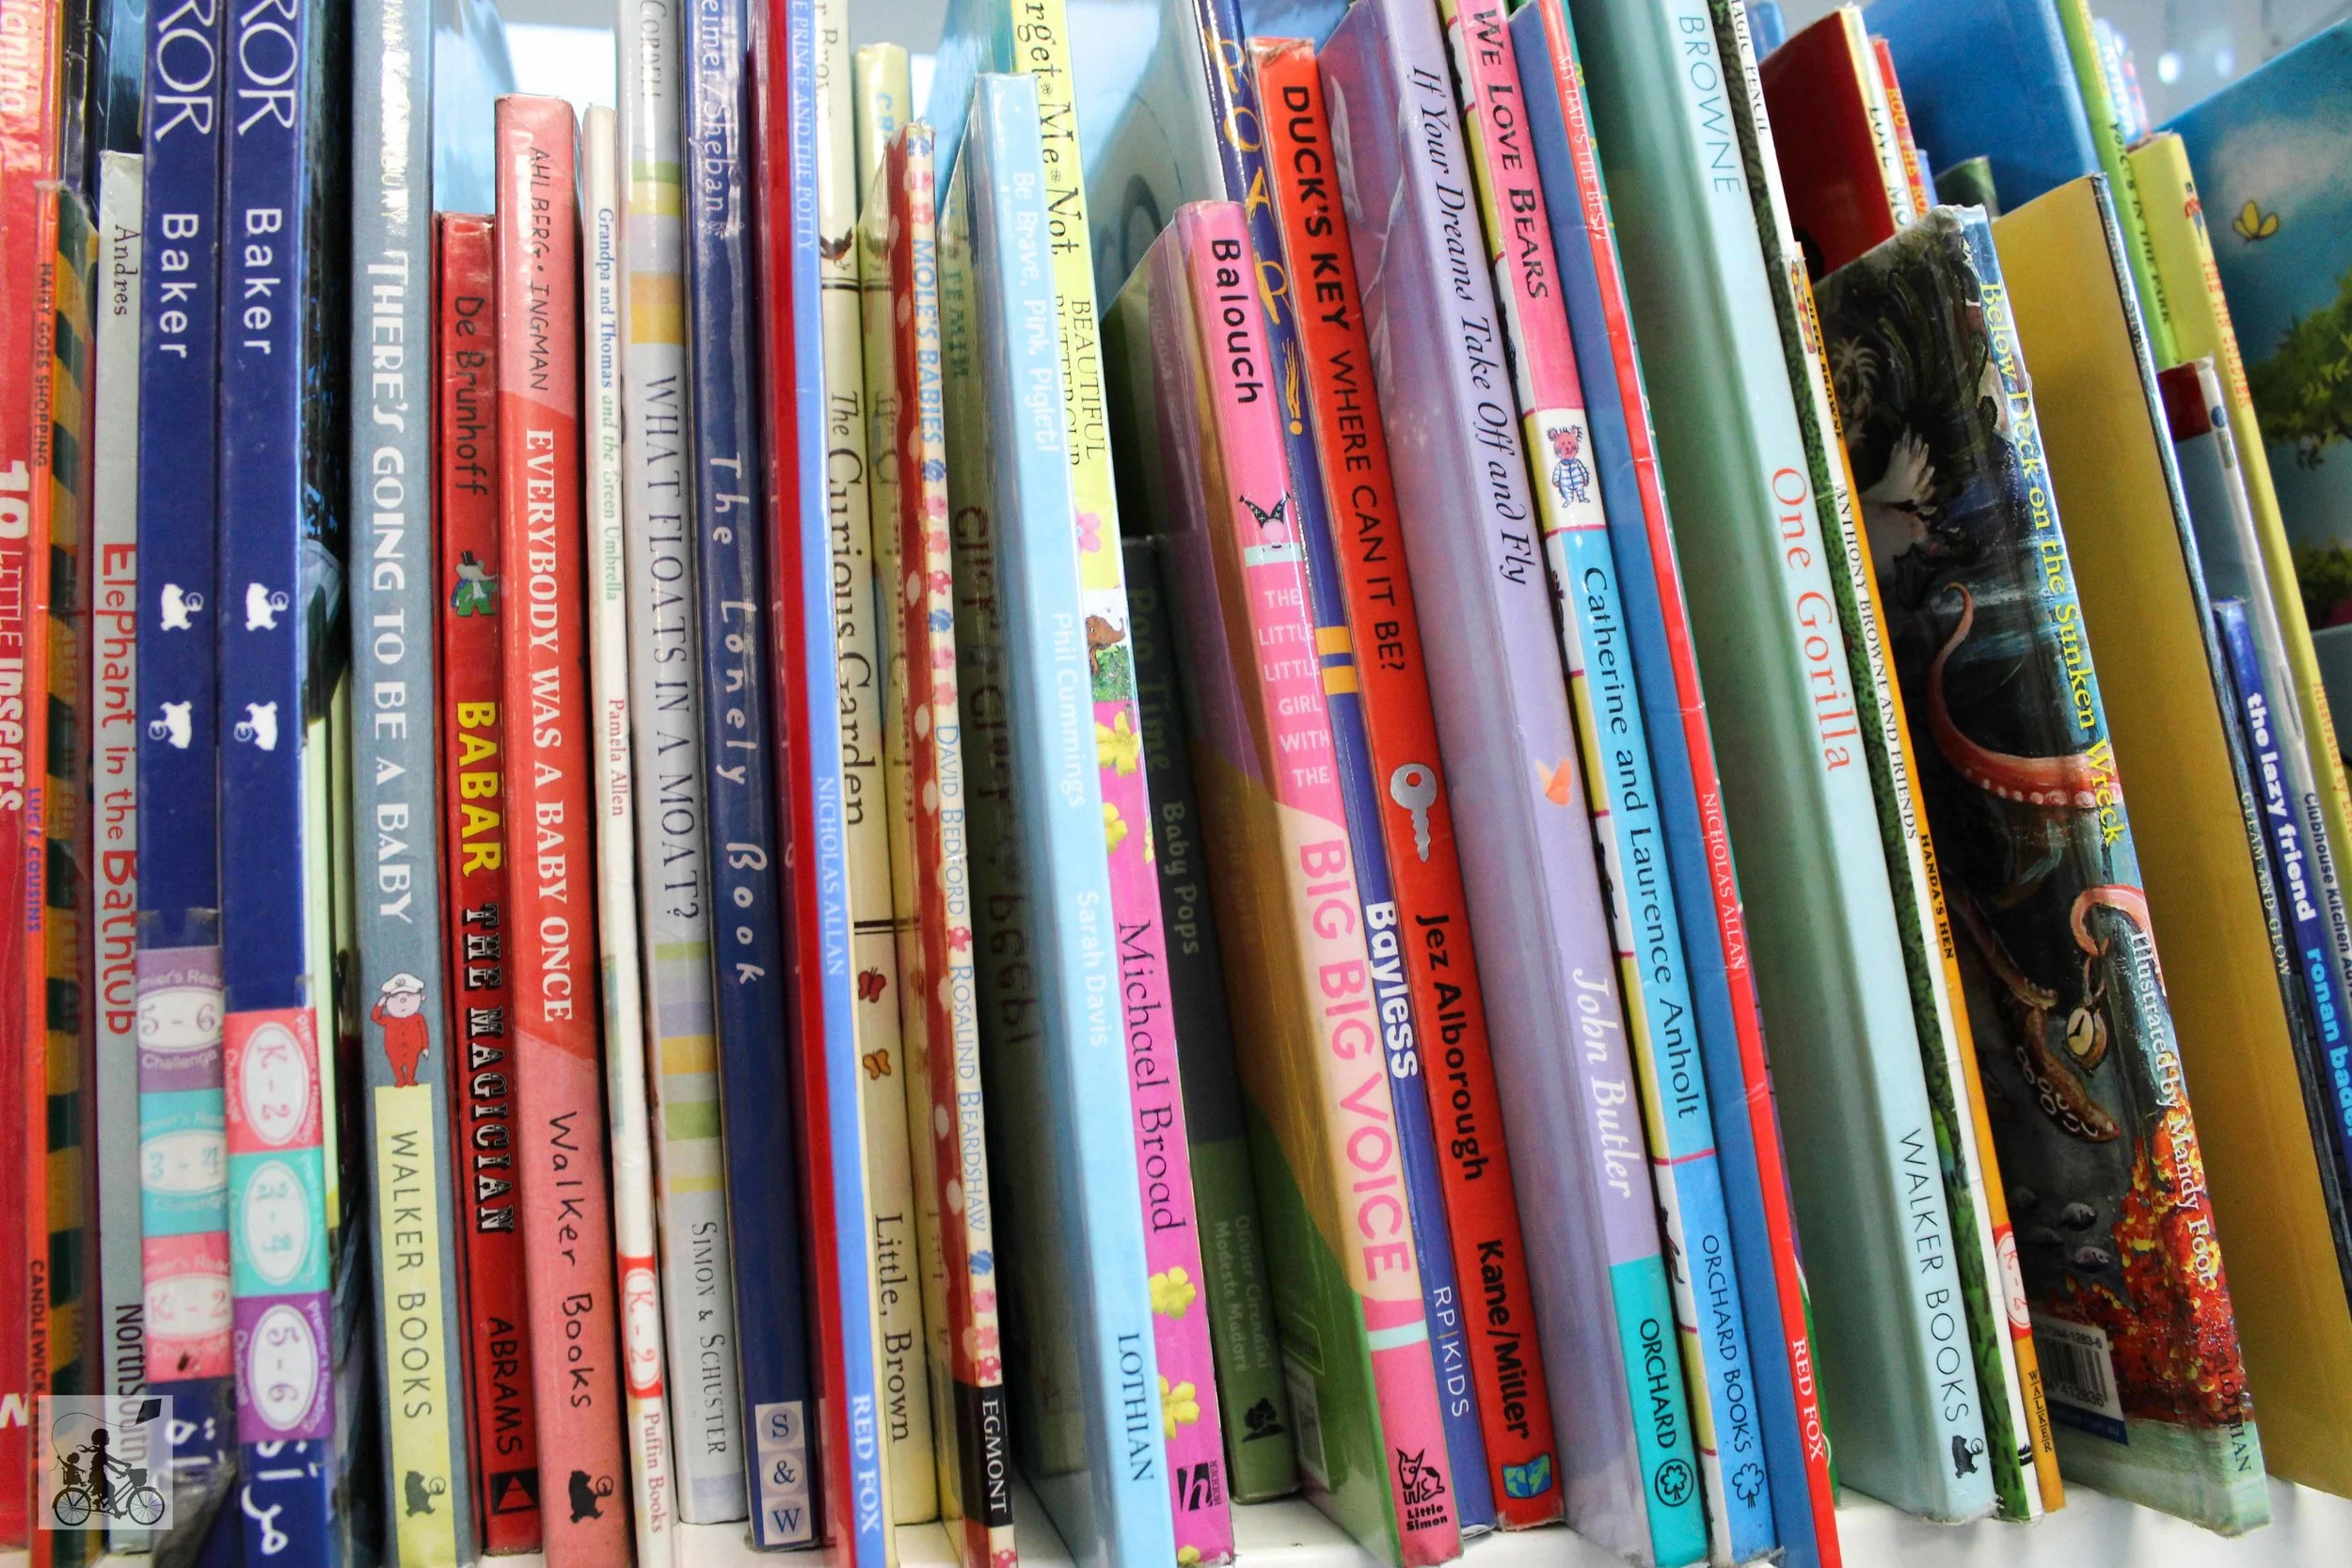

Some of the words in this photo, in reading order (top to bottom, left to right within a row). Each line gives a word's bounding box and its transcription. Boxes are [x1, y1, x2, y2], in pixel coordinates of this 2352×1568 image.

[792, 17, 810, 87] PRINCE
[1474, 8, 1502, 67] WE
[794, 93, 811, 137] AND
[1420, 103, 1452, 175] Your
[1486, 85, 1522, 171] LOVE
[1678, 16, 1741, 194] BROWNE
[795, 142, 812, 181] THE
[1015, 172, 1036, 200] Be
[1281, 85, 1332, 237] DUCK'S
[530, 148, 551, 270] AHLBERG
[596, 208, 616, 281] Grandpa
[797, 186, 814, 252] POTTY
[1014, 211, 1039, 285] Brave,
[1435, 181, 1474, 303] Dreams
[1508, 187, 1549, 300] BEARS
[40, 263, 52, 315] MAISY
[113, 224, 141, 317] Andres
[160, 214, 199, 358] Baker
[455, 295, 485, 338] De
[599, 284, 615, 315] and
[912, 240, 936, 341] MOLE'S
[1311, 251, 1351, 331] KEY
[38, 321, 50, 369] GOES
[366, 249, 409, 435] THERE'S
[530, 279, 549, 391] INGMAN
[600, 320, 617, 388] Thomas
[1024, 299, 1047, 357] Pink
[1212, 239, 1264, 404] Balouch
[1460, 315, 1500, 391] Take
[1980, 281, 2017, 381] Below
[36, 374, 50, 467] SHOPPING
[455, 351, 487, 496] Brunhoff
[601, 395, 616, 424] and
[831, 391, 858, 436] The
[916, 349, 944, 444] BABIES
[1029, 368, 1060, 451] Piglet!
[1072, 300, 1106, 460] BEAUTIFUL
[1329, 349, 1371, 472] WHERE
[602, 435, 618, 463] the
[645, 374, 682, 508] WHAT
[1476, 399, 1516, 459] Off
[2005, 388, 2040, 475] Deck
[372, 446, 406, 593] GOING
[710, 454, 751, 547] The
[1349, 484, 1388, 562] CAN
[1489, 459, 1528, 522] and
[1836, 480, 1866, 595] ANTHONY
[2027, 490, 2052, 529] on
[526, 428, 559, 654] EVERYBODY
[604, 526, 620, 601] Umbrella
[828, 449, 863, 637] Curious
[1499, 529, 1535, 586] Fly
[2036, 543, 2067, 594] the
[649, 515, 687, 664] FLOATS
[1052, 613, 1073, 656] Phil
[1258, 625, 1314, 646] LITTLE
[1264, 590, 1301, 607] THE
[1366, 577, 1394, 606] IT
[1772, 467, 1812, 569] One
[1796, 590, 1861, 772] Gorilla
[95, 543, 135, 736] Elephant
[373, 614, 406, 665] TO
[1264, 659, 1322, 682] LITTLE
[1375, 619, 1405, 672] BE?
[1584, 567, 1627, 735] Catherine
[1859, 599, 1888, 691] BROWNE
[2054, 603, 2095, 730] Sunken
[373, 683, 406, 740] BE
[532, 669, 561, 749] WAS
[609, 698, 627, 764] Pamela
[655, 681, 690, 714] IN
[717, 599, 757, 784] Lonely
[1055, 663, 1084, 809] Cummings
[1278, 697, 1323, 715] GIRL
[1880, 695, 1899, 741] AND
[106, 745, 132, 775] in
[836, 652, 876, 826] Garden
[935, 725, 960, 798] DAVID
[1279, 730, 1331, 752] WITH
[1292, 768, 1331, 787] THE
[1617, 749, 1647, 813] and
[28, 787, 42, 836] LUCY
[105, 792, 135, 840] the
[456, 702, 501, 879] BABAR
[611, 770, 628, 816] Allen
[818, 776, 840, 891] NICHOLAS
[1887, 749, 1918, 839] FRIENDS
[2082, 740, 2125, 847] Wreck
[2246, 691, 2269, 743] the
[2259, 752, 2287, 816] lazy
[2278, 822, 2318, 924] friend
[376, 803, 413, 925] BABY
[535, 802, 567, 903] BABY
[660, 774, 700, 921] MOAT?
[940, 808, 965, 915] BEDFORD
[1164, 800, 1186, 879] Baby
[2241, 792, 2264, 861] GLEAM
[2255, 863, 2277, 907] AND
[2268, 916, 2292, 976] GLOW
[2303, 792, 2333, 883] Clubhouse
[2328, 889, 2351, 962] Kitchen
[26, 847, 41, 933] COUSINS
[727, 844, 768, 985] Book
[823, 896, 844, 977] ALLAN
[1077, 892, 1102, 967] Sarah
[1174, 883, 1199, 955] Pops
[1300, 839, 1356, 940] BIG
[1629, 827, 1672, 985] Laurence
[1920, 834, 1946, 919] HANDA'S
[1938, 924, 1954, 959] HEN
[102, 851, 135, 1034] Bathtub
[464, 904, 501, 990] THE
[539, 916, 573, 1022] ONCE
[948, 965, 975, 1081] ROSALIND
[1084, 977, 1106, 1047] Davis
[1118, 921, 1169, 1089] Michael
[1318, 951, 1375, 1060] BIG
[1365, 901, 1420, 1080] Bayless
[1574, 969, 1610, 1063] John
[2131, 931, 2177, 1069] Illustrated
[2307, 948, 2340, 1042] ronan
[1416, 913, 1450, 970] Jez
[1434, 981, 1488, 1180] Alborough
[1660, 997, 1700, 1118] Anholt
[2156, 1069, 2182, 1109] by
[469, 1007, 515, 1235] MAGICIAN
[957, 1091, 986, 1232] BEARDSHAW
[1591, 1077, 1641, 1199] Butler
[2168, 1117, 2200, 1212] Mandy
[391, 1131, 424, 1273] WALKER
[549, 1112, 585, 1267] Walker
[1139, 1106, 1187, 1232] Broad
[1339, 1072, 1411, 1282] VOICE
[692, 1222, 717, 1296] SIMON
[875, 1213, 902, 1317] Little,
[1899, 1128, 1944, 1274] WALKER
[1926, 1289, 1969, 1423] BOOKS
[2187, 1218, 2218, 1284] Foot
[30, 1259, 45, 1397] CANDLEWICK
[397, 1293, 432, 1418] BOOKS
[564, 1294, 596, 1408] Books
[1477, 1239, 1530, 1441] Kane/Miller
[1703, 1234, 1739, 1359] ORCHARD
[1724, 1369, 1753, 1453] BOOKS
[489, 1318, 523, 1456] ABRAMS
[699, 1334, 726, 1455] SCHUSTER
[852, 1395, 875, 1459] RED
[884, 1330, 914, 1443] Brown
[1118, 1333, 1154, 1481] LOTHIAN
[1639, 1317, 1677, 1449] ORCHARD
[2027, 1370, 2053, 1452] WALKER
[2217, 1366, 2250, 1473] LOTHIAN
[644, 1413, 660, 1471] Puffin
[982, 1401, 1007, 1513] EGMONT
[648, 1478, 665, 1534] Books
[858, 1467, 881, 1534] FOX
[1406, 1505, 1444, 1517] Little
[1406, 1515, 1449, 1531] Simon
